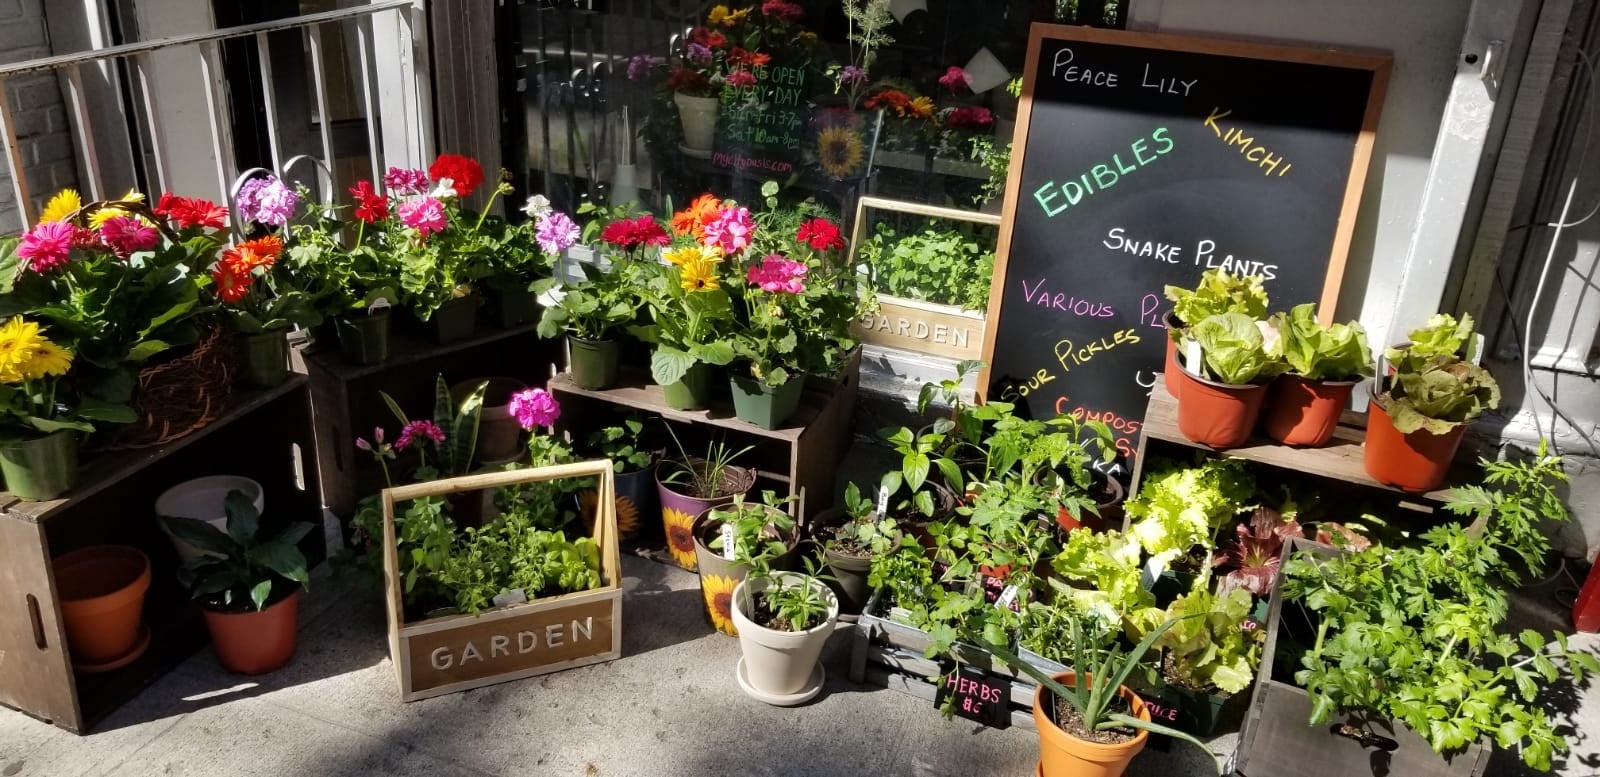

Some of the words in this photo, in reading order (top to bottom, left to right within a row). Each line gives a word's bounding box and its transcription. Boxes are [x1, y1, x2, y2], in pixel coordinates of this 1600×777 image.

[725, 60, 769, 81] WERE
[771, 66, 805, 87] OPEN
[1052, 48, 1118, 88] PEACE
[1142, 63, 1198, 97] LILY
[723, 82, 768, 103] EVERY
[774, 86, 802, 107] DAY
[727, 123, 753, 142] Sat
[1204, 107, 1292, 177] KIMCHI
[1033, 127, 1175, 217] EDIBLES
[1103, 228, 1182, 264] SNAKE
[1195, 240, 1279, 280] PLANTS
[1022, 278, 1115, 318] VARIOUS
[861, 311, 969, 349] GARDEN
[1001, 368, 1056, 402] SOUR
[1055, 328, 1141, 372] PICKLES
[1056, 396, 1145, 434] COMPOS
[431, 617, 593, 671] GARDEN
[947, 675, 1002, 703] HERBS
